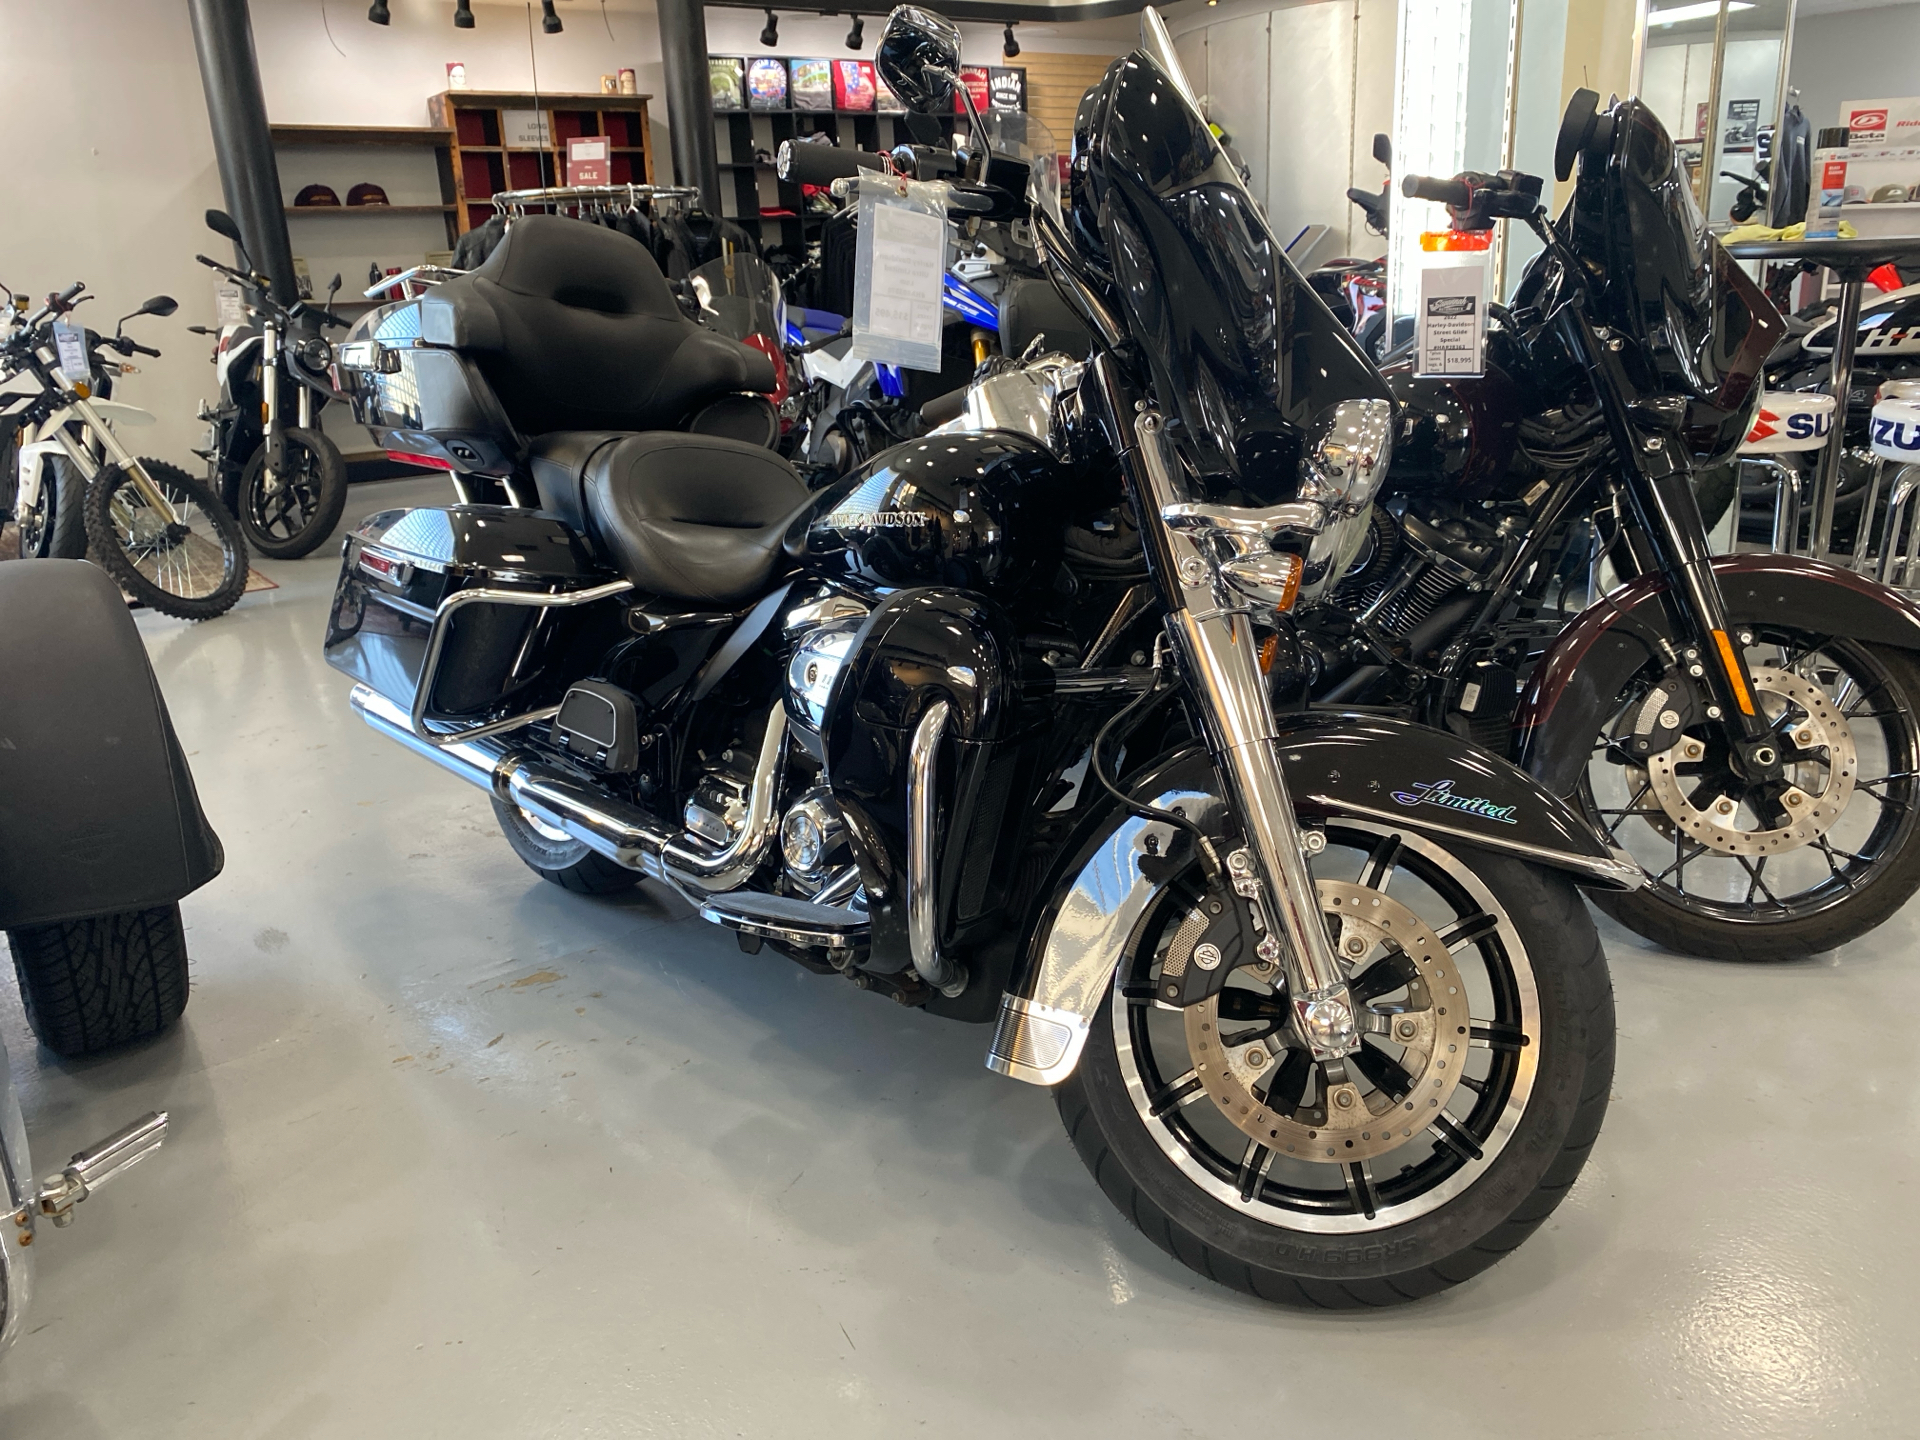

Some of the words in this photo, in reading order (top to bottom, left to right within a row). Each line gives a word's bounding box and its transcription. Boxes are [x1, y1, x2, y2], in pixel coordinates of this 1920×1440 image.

[990, 76, 1021, 93] INDIAN
[1849, 132, 1885, 140] Beta
[579, 172, 598, 180] SALE
[1389, 779, 1518, 825] Limited
